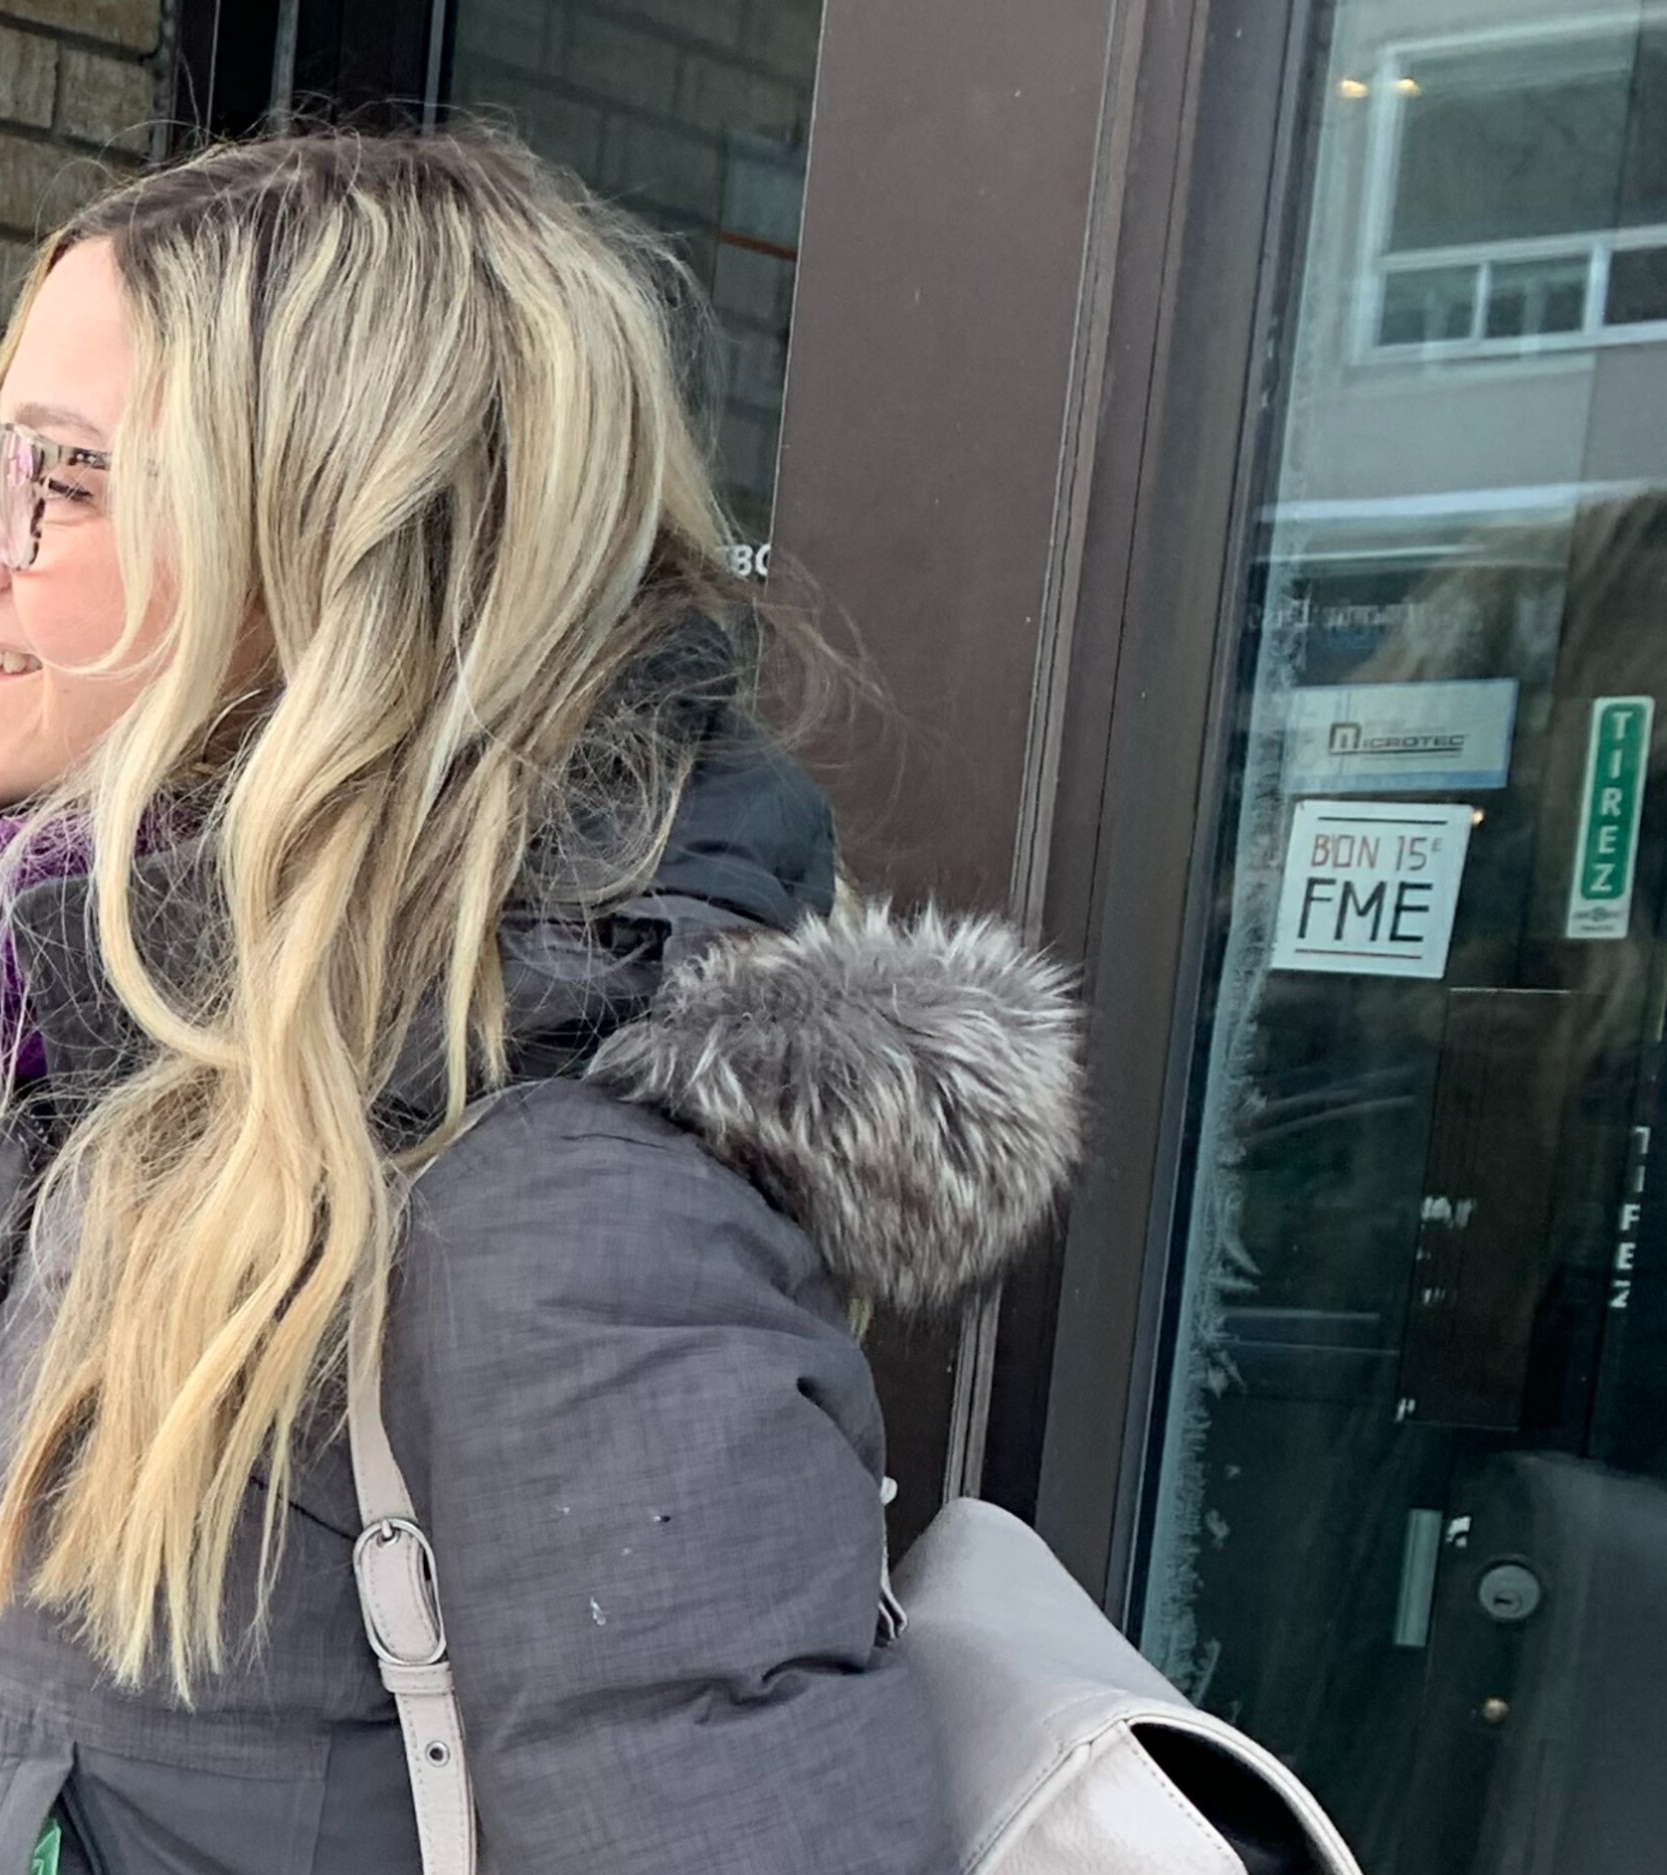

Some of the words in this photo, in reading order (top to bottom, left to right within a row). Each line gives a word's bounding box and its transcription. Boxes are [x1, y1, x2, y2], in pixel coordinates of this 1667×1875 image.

[1328, 720, 1467, 751] MICROTEC
[1589, 710, 1634, 894] TIREZ
[1310, 833, 1380, 871] BON
[1296, 876, 1435, 944] FME
